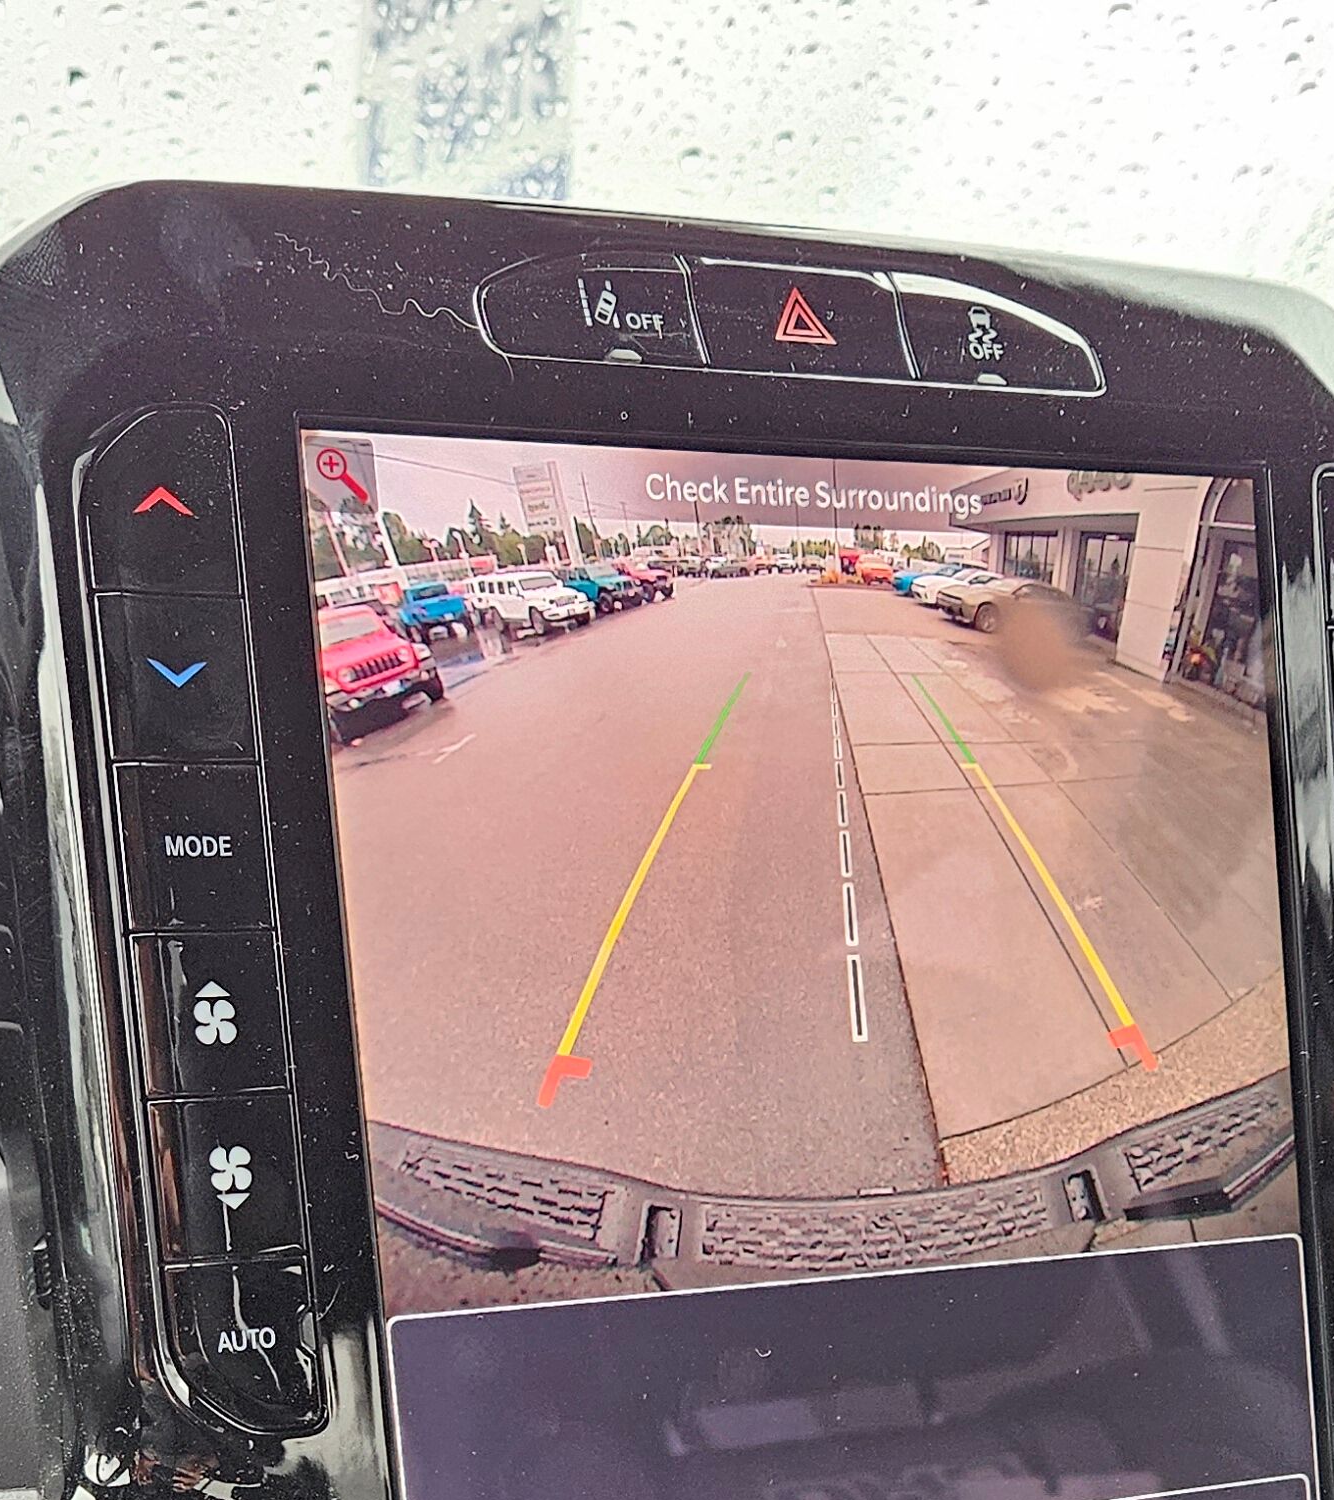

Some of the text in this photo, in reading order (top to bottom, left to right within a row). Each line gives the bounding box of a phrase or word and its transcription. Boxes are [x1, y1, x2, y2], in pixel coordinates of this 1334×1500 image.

[626, 312, 665, 331] OFF
[969, 341, 1004, 362] OFF
[645, 473, 727, 505] Check
[734, 478, 811, 509] Entire
[815, 482, 982, 518] Surroundings
[165, 835, 233, 857] MODE
[218, 1326, 276, 1353] AUTO
